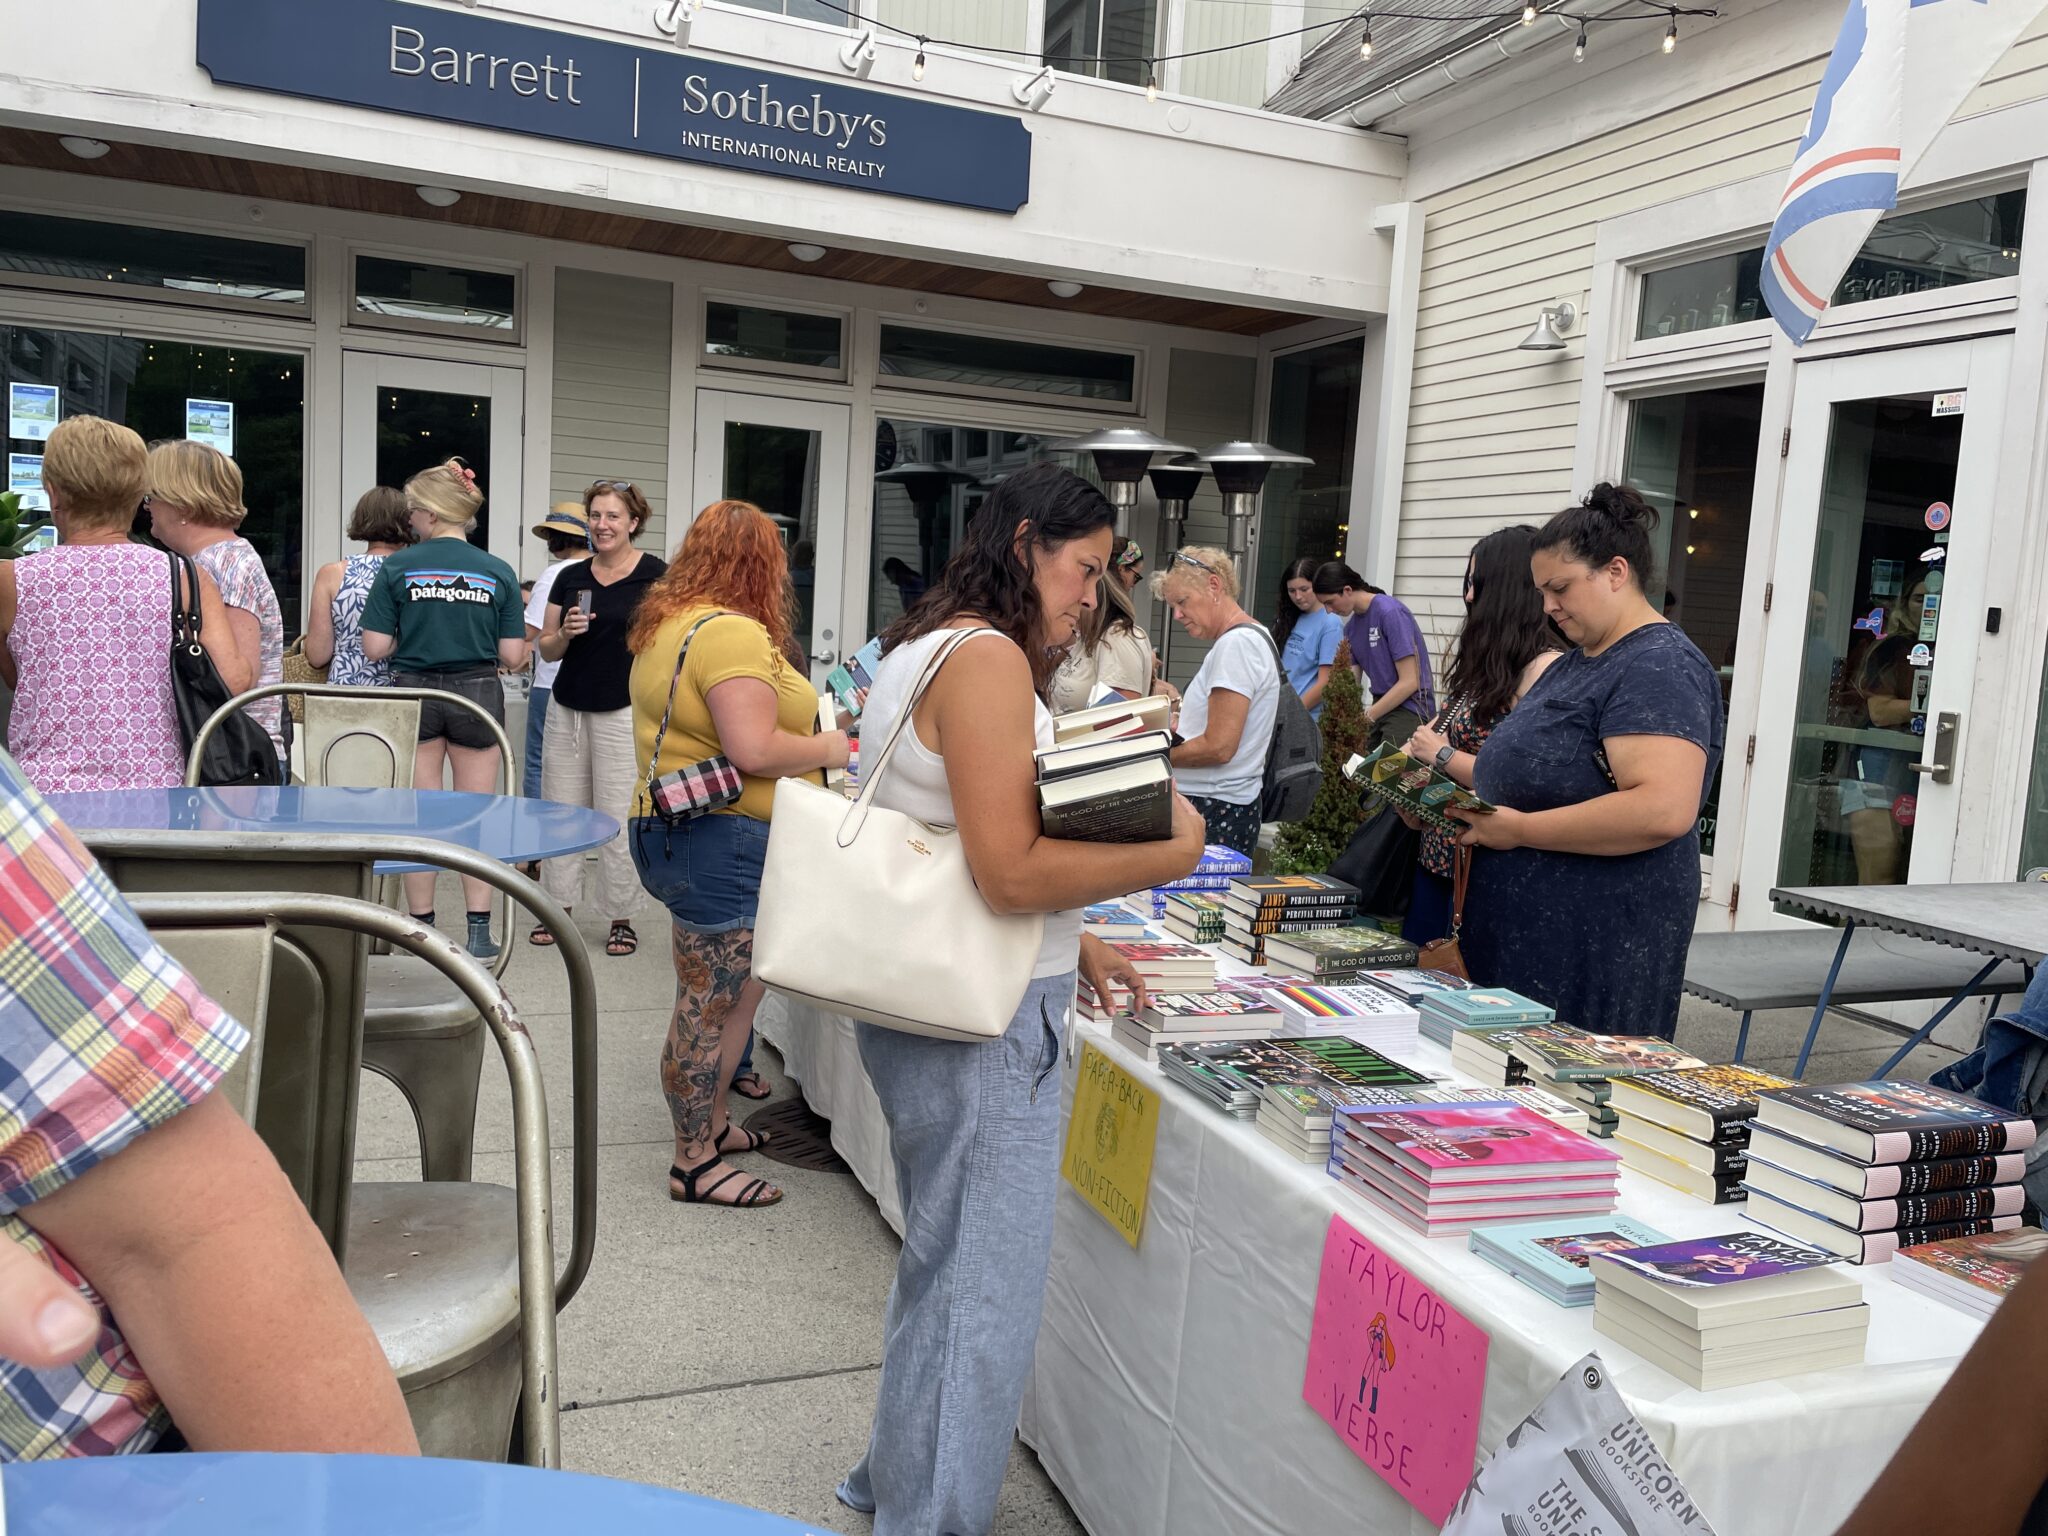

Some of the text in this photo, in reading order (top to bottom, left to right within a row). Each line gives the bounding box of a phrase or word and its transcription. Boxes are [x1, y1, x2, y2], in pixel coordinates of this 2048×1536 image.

[390, 24, 582, 105] Barrett
[683, 75, 887, 150] Sotheby's
[682, 130, 886, 178] INTERNATIONAL REALTY
[411, 586, 490, 604] patagonia
[1056, 790, 1160, 820] THE GOD OF THE WOODS
[1205, 862, 1223, 874] EMILY
[1224, 861, 1242, 873] HENRY
[1178, 877, 1198, 888] STORY
[1204, 876, 1222, 888] EMILY
[1264, 893, 1347, 907] JAMES PERCIVAL EVERETT
[1253, 921, 1276, 935] JAMES
[1280, 924, 1308, 932] PERCIVAL
[1259, 908, 1343, 921] JAMES PERCIVAL EVERETT
[1331, 959, 1340, 967] THE
[1341, 958, 1357, 967] GOD
[1358, 957, 1366, 965] OF
[1367, 956, 1376, 964] THE
[1377, 953, 1403, 962] WOODS
[1340, 978, 1356, 986] GOD
[1364, 987, 1396, 1003] GREAT
[1338, 988, 1384, 1014] SPEECHES
[1273, 1041, 1368, 1085] DIFFERENT
[1296, 1039, 1421, 1083] BUILT
[1812, 1093, 1892, 1121] DEMON
[1832, 1090, 1918, 1119] UNREST
[1887, 1082, 1995, 1118] LARSON
[1726, 1127, 1741, 1135] Haidt
[1729, 1161, 1746, 1169] Haidt
[1071, 1153, 1140, 1236] NON-FICTION
[1730, 1192, 1746, 1200] Haidt
[1719, 1242, 1808, 1267] SWIFT
[1739, 1234, 1846, 1263] TAYLOR
[1930, 1249, 1981, 1271] SOUL
[1348, 1237, 1446, 1348] TAYLOR
[1333, 1383, 1413, 1488] VERSE
[1598, 1437, 1663, 1513] BOOKSTORE
[1610, 1422, 1699, 1526] UNICORN
[1552, 1477, 1587, 1524] THE
